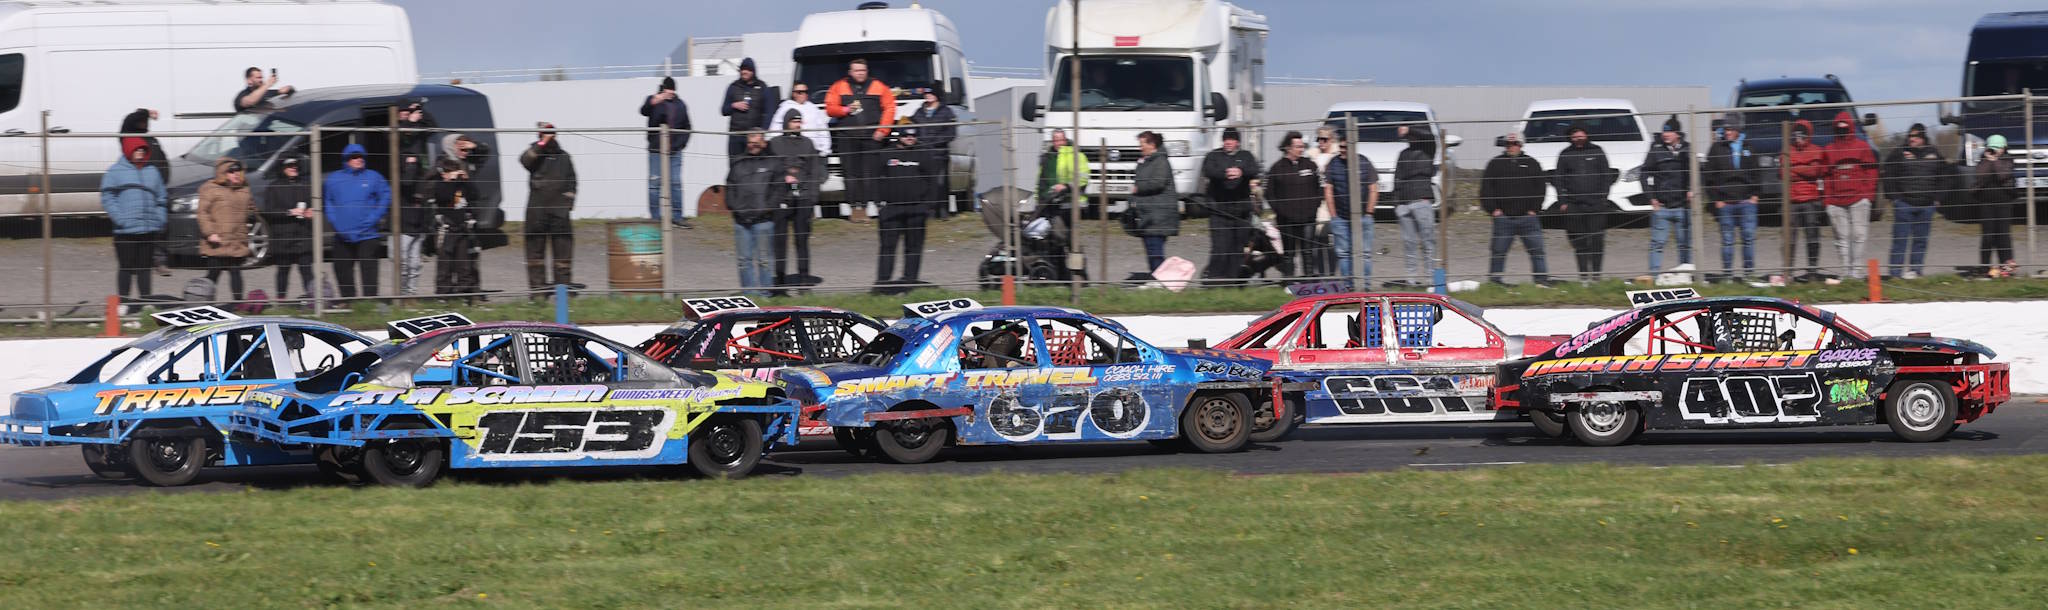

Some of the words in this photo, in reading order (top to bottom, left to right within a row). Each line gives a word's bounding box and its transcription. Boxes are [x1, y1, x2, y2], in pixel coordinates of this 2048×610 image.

[1297, 283, 1340, 297] 661
[687, 297, 756, 314] 389
[917, 299, 972, 314] 670
[394, 314, 472, 337] 153
[1713, 312, 1728, 342] JACK
[1521, 354, 1667, 378] NORTH
[1660, 349, 1819, 373] STREET
[1819, 348, 1880, 363] GARAGE
[1105, 365, 1145, 374] COACH
[1148, 364, 1177, 373] HIRE
[1194, 358, 1228, 375] BIG
[833, 371, 958, 397] SMART
[964, 367, 1098, 389] TRAVEL
[445, 384, 610, 406] SCREEN
[609, 388, 693, 400] WINDSCREEN
[988, 387, 1151, 443] 670
[475, 408, 677, 461] 153
